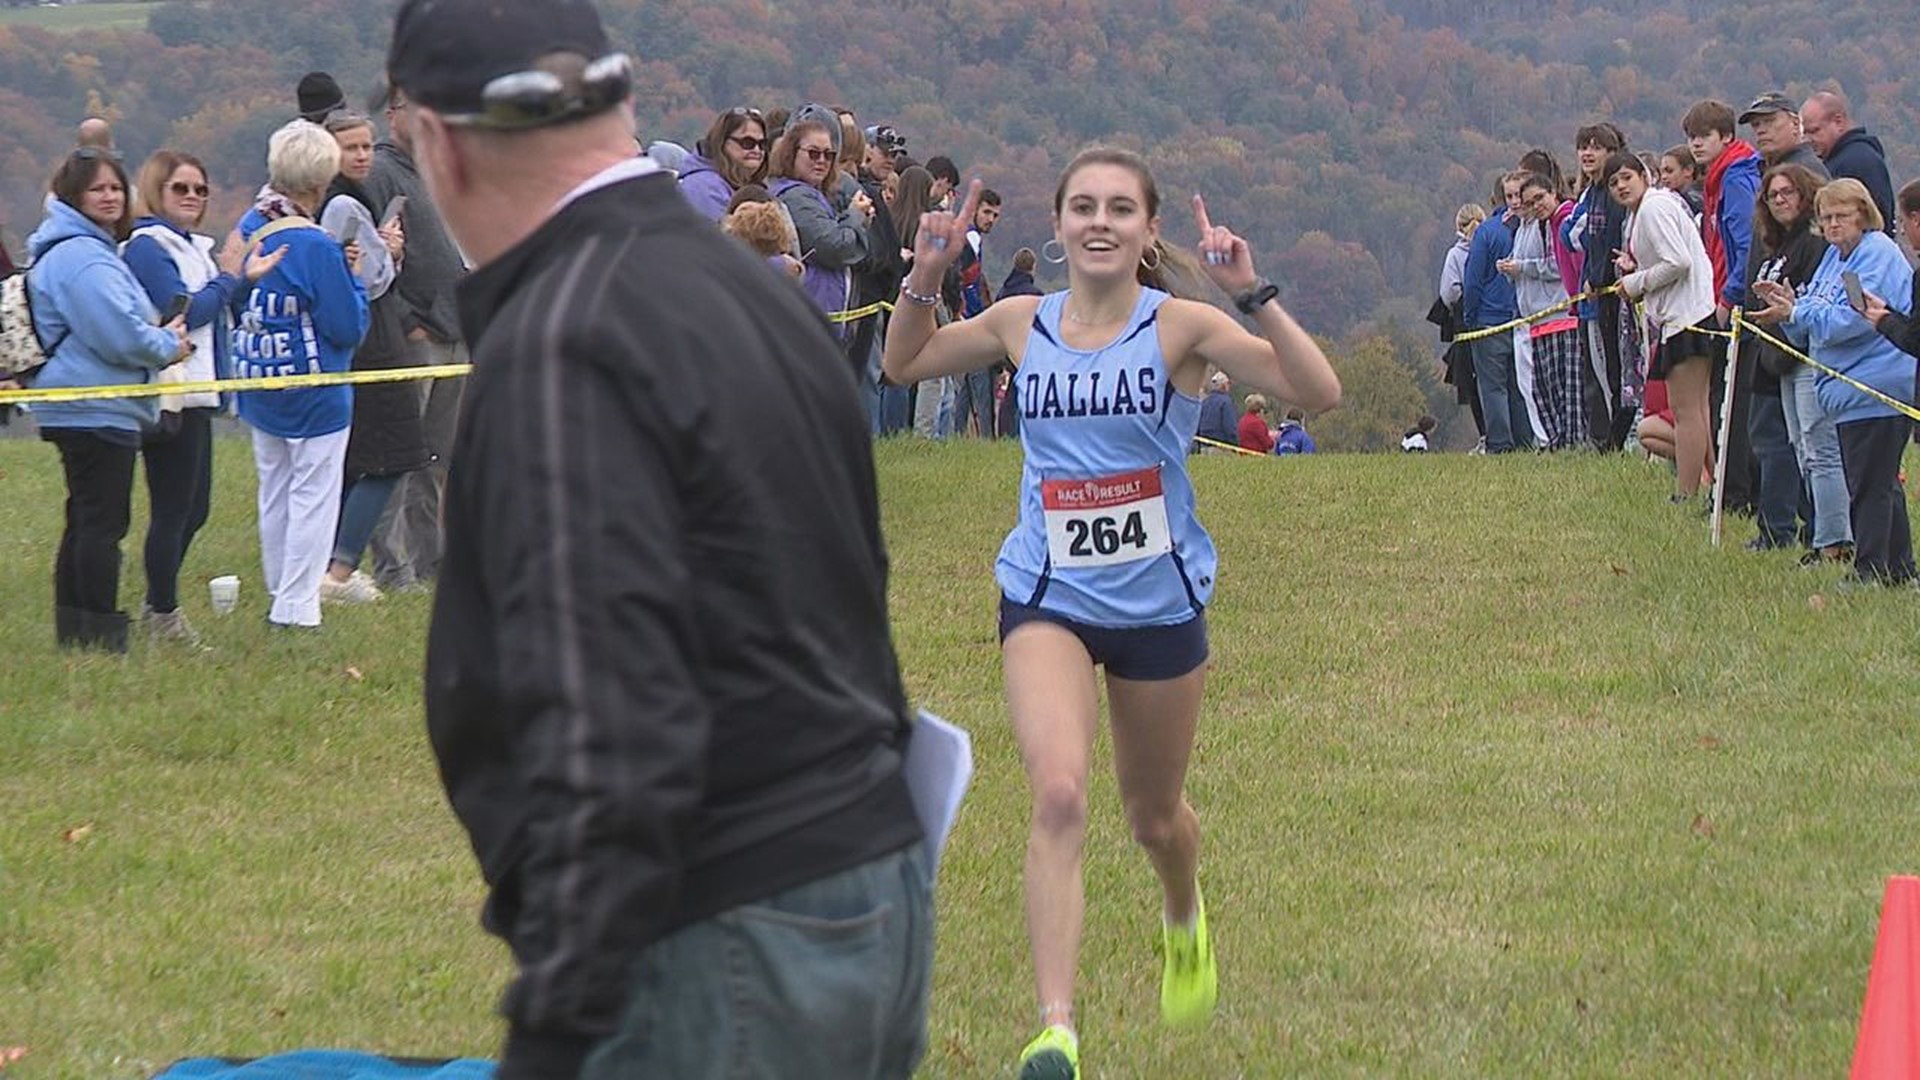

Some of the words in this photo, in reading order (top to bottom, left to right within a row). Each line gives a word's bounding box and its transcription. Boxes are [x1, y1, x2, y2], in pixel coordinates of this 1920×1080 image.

[1025, 367, 1156, 418] DALLAS
[1057, 488, 1085, 502] RACE
[1100, 481, 1141, 499] RESULT
[1066, 511, 1147, 557] 264
